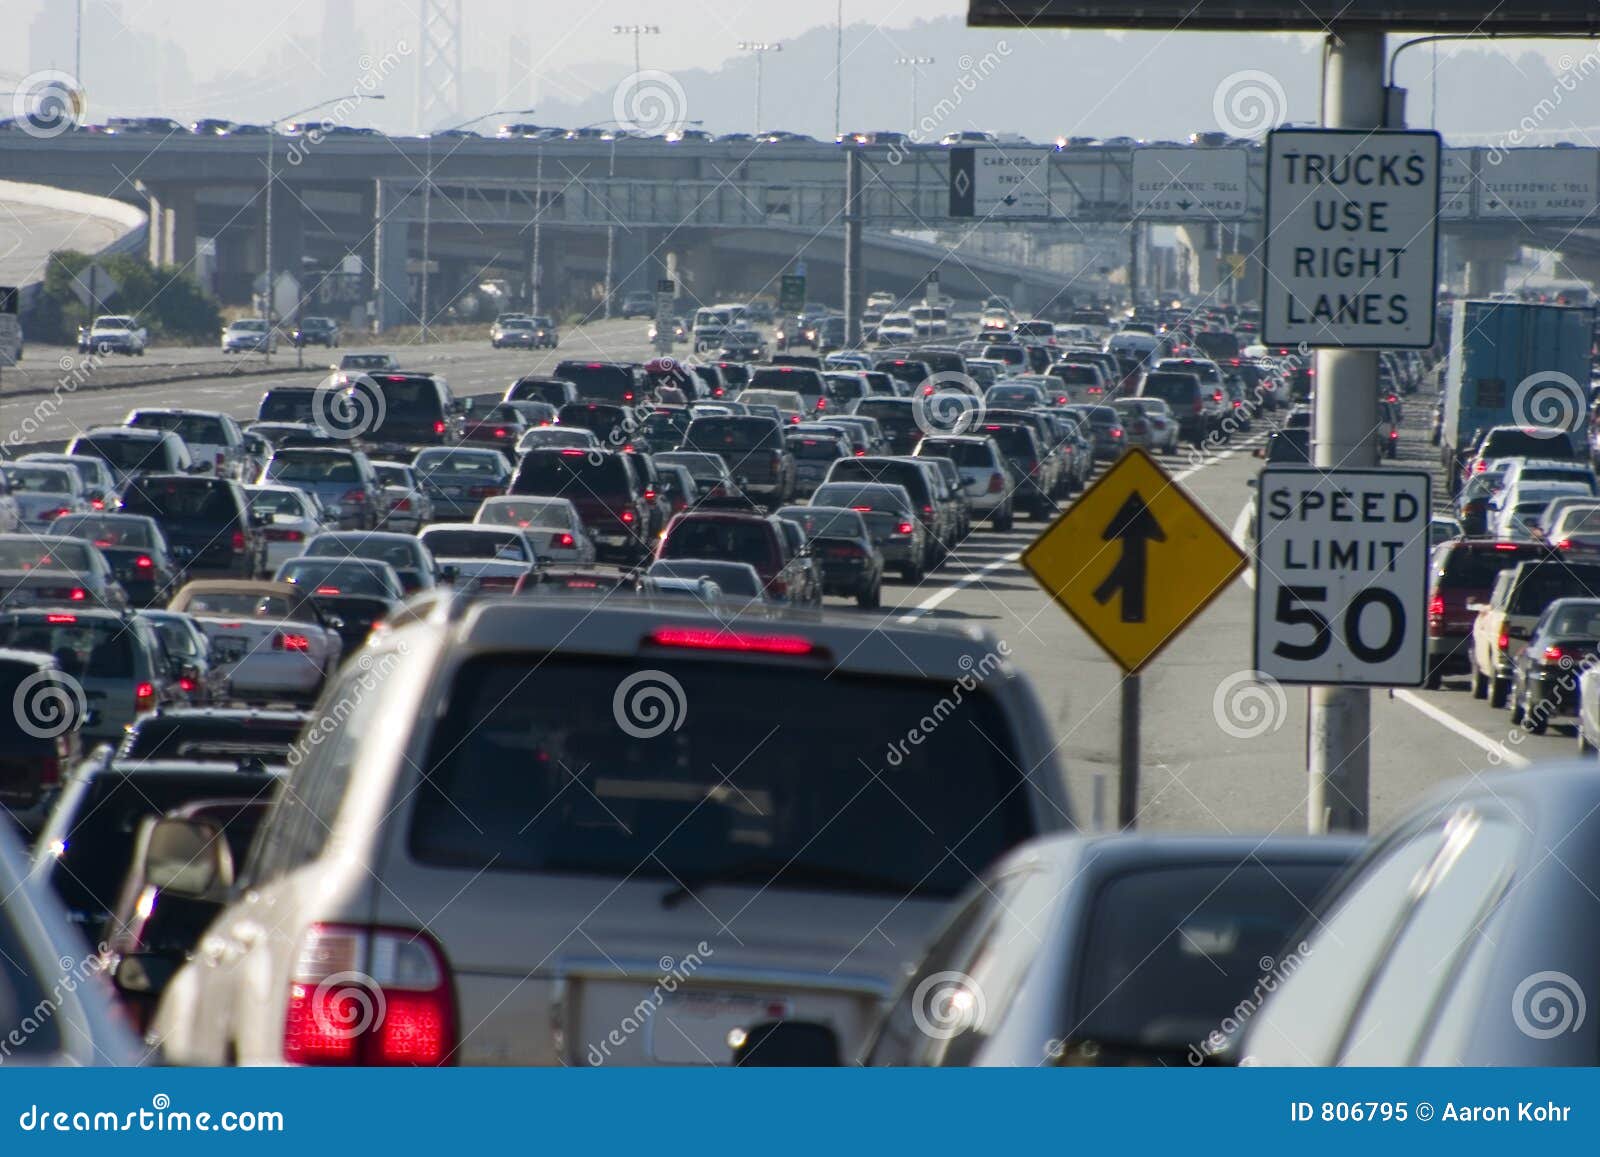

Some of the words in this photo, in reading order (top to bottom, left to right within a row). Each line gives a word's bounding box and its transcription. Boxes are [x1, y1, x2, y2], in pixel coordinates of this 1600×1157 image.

[1282, 154, 1425, 187] TRUCKS
[1315, 201, 1388, 232] USE
[1294, 247, 1407, 279] RIGHT
[1287, 294, 1409, 325] LANES
[1268, 489, 1419, 523] SPEED
[1285, 539, 1404, 572] LIMIT
[1273, 585, 1407, 664] 50
